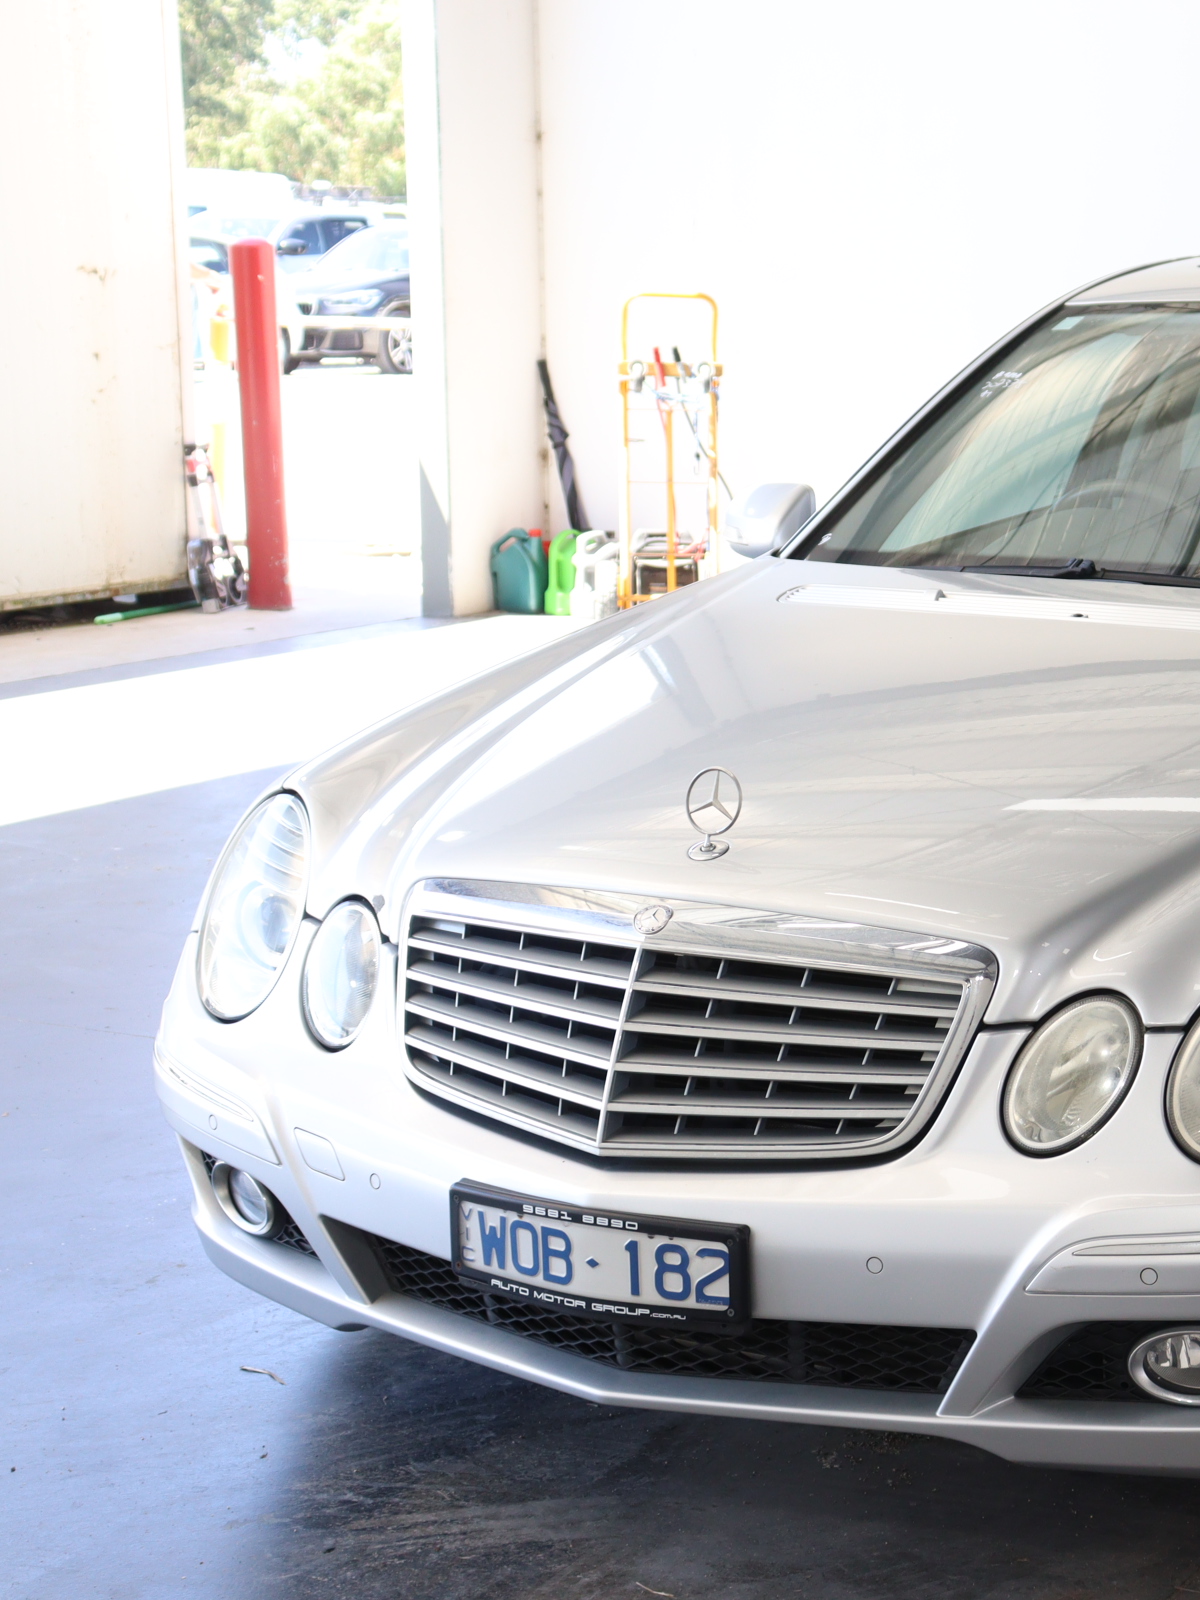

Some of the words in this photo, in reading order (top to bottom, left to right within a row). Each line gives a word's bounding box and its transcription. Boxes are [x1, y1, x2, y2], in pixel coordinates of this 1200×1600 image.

[461, 1204, 475, 1262] VIC
[522, 1204, 572, 1221] 9681
[582, 1214, 638, 1231] 8890
[478, 1210, 573, 1286] WOB
[623, 1239, 730, 1306] 182
[490, 1278, 529, 1297] AUTO
[533, 1290, 587, 1309] MOTOR
